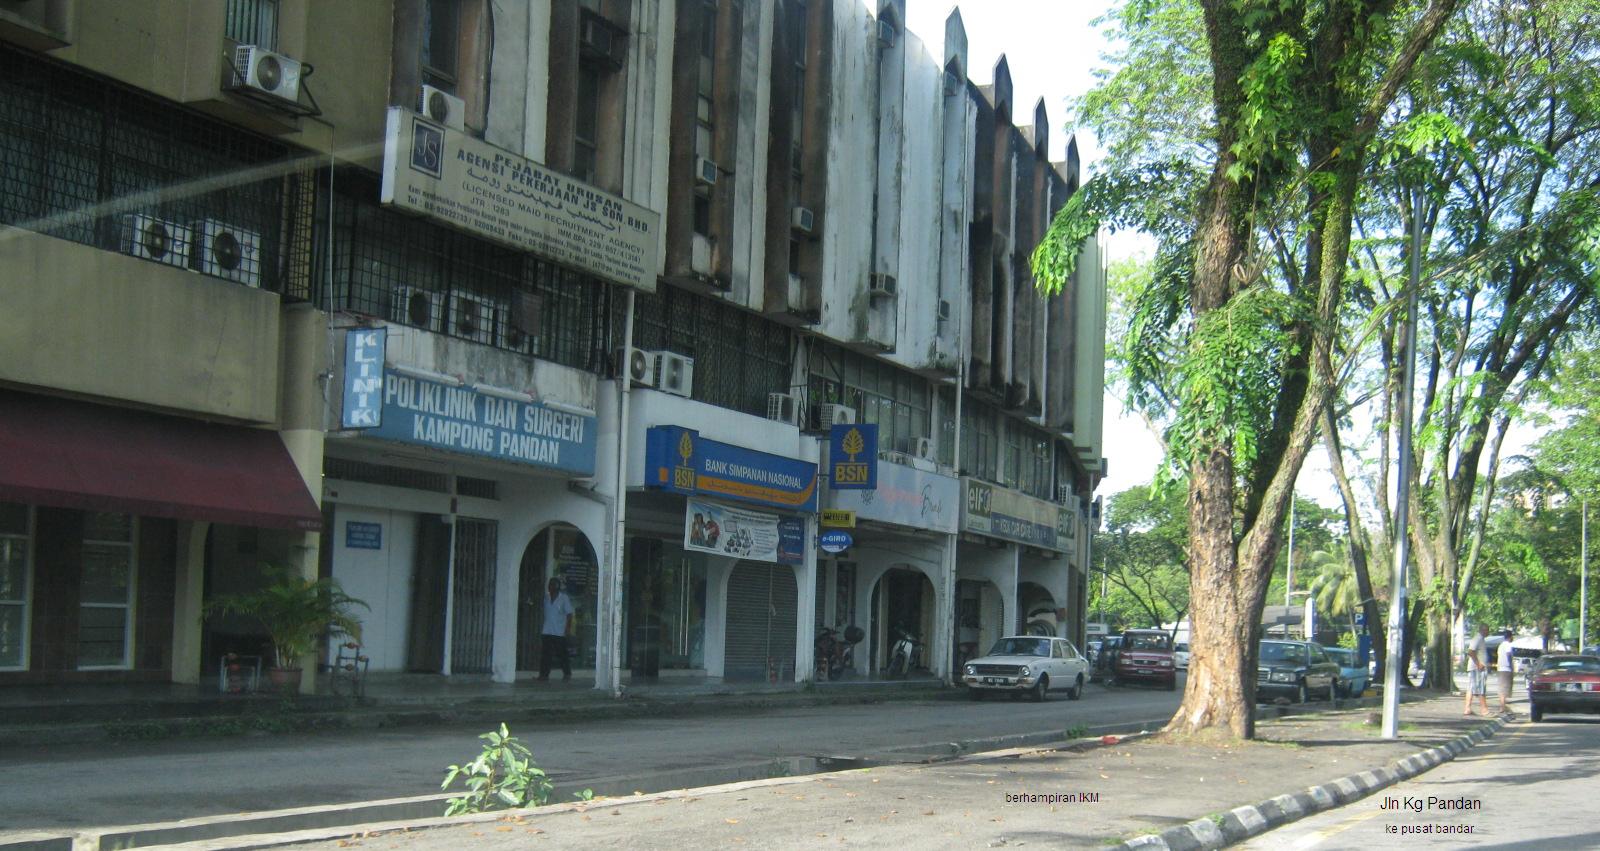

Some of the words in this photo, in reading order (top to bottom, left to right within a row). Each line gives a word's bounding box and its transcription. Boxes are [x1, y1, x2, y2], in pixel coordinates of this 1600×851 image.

[456, 148, 505, 177] AGENSI
[511, 169, 580, 206] PEKERJAAN
[494, 153, 560, 187] PEJABAT
[566, 183, 623, 212] URUSAN
[461, 180, 515, 208] (LICENSED
[518, 202, 541, 218] MAID
[544, 213, 606, 241] RECRUITMENT
[351, 333, 378, 424] KLINIK
[385, 373, 477, 422] POLIKLINIK
[484, 396, 517, 430] DAN
[524, 402, 585, 444] SURGERI
[413, 414, 494, 452] KAMPONG
[500, 435, 560, 465] PANDAN
[674, 469, 694, 487] BSN
[705, 459, 727, 475] BANK
[728, 463, 767, 483] SIMPANAN
[768, 470, 803, 489] NASIONAL
[835, 465, 868, 482] BSN
